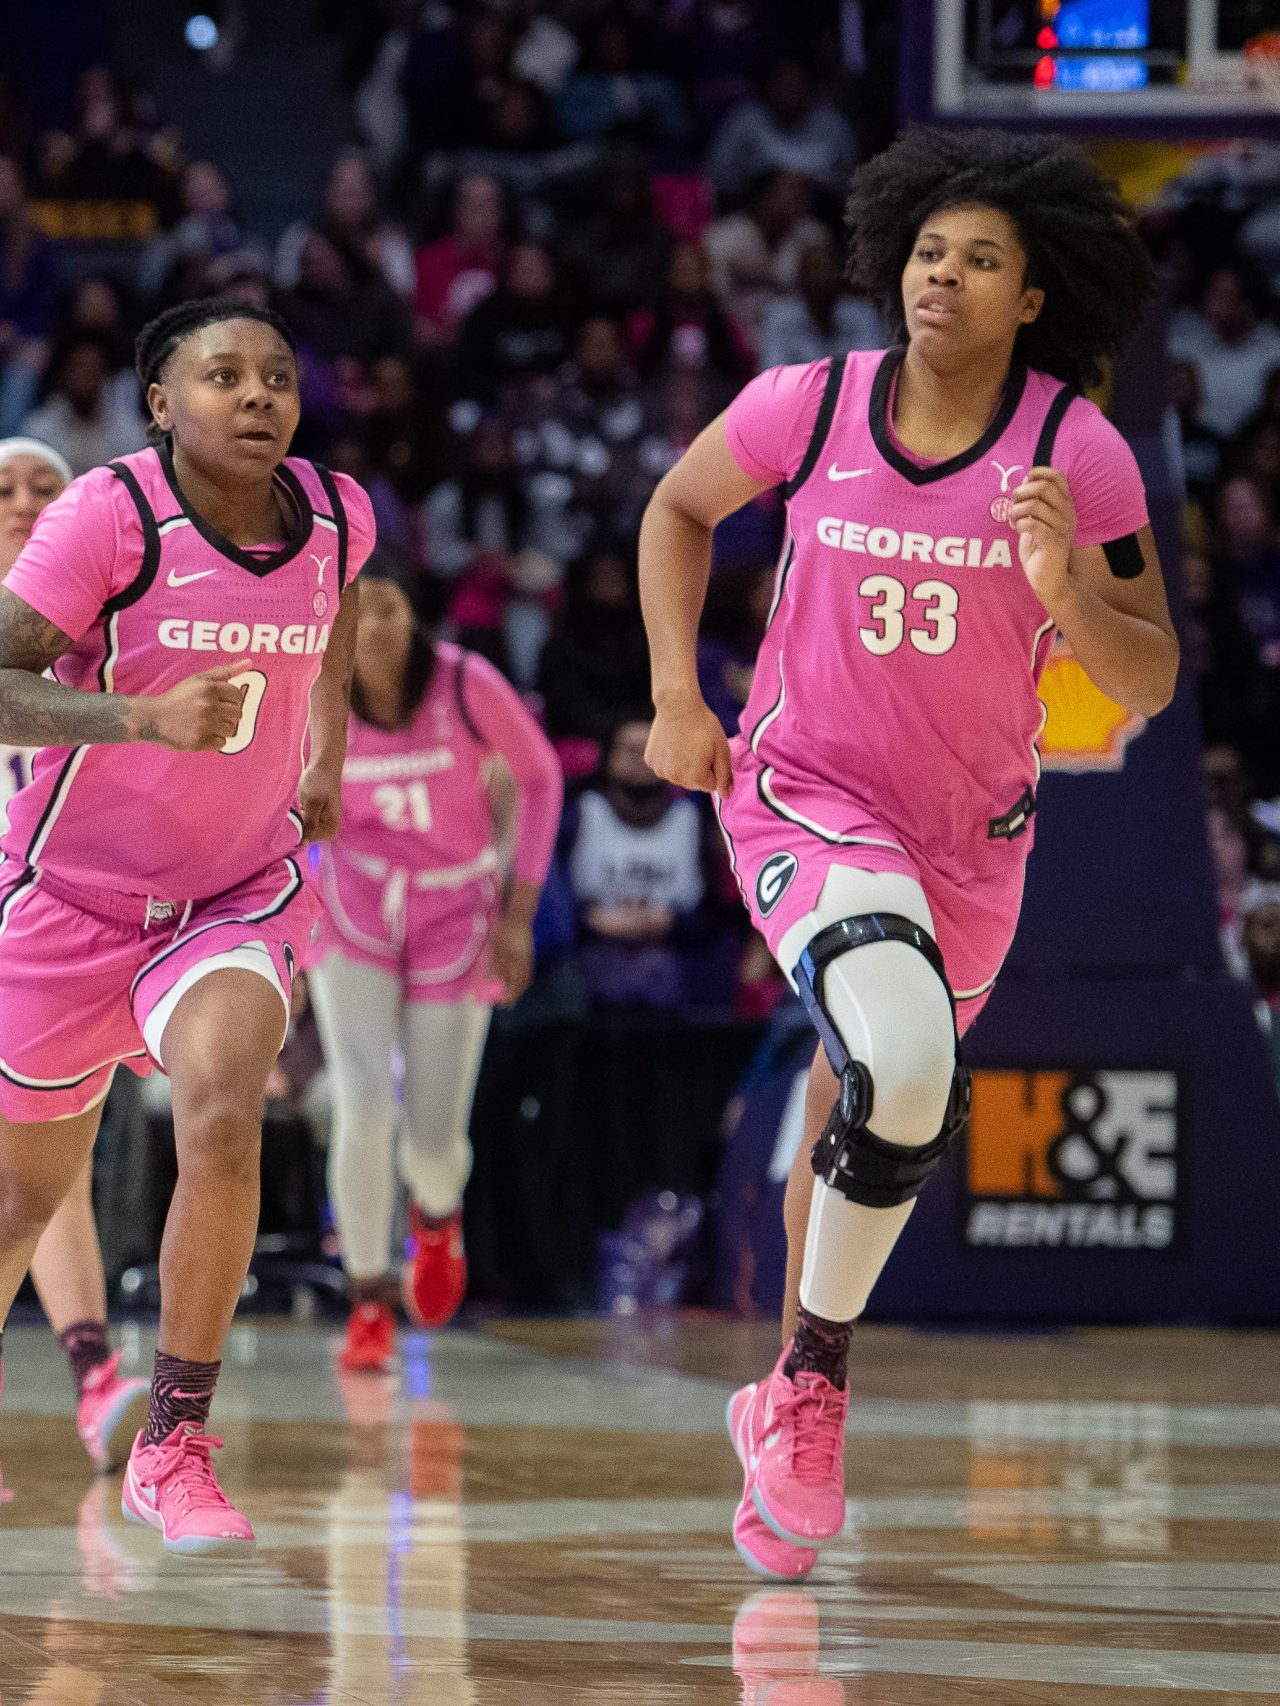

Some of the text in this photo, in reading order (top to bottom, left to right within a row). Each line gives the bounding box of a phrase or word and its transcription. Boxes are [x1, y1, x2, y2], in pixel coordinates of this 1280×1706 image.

[816, 516, 1013, 569] GEORGIA
[158, 618, 329, 655] GEORGIA
[858, 573, 959, 657] 33
[373, 780, 432, 832] 21
[969, 1203, 1175, 1249] RENTALS
